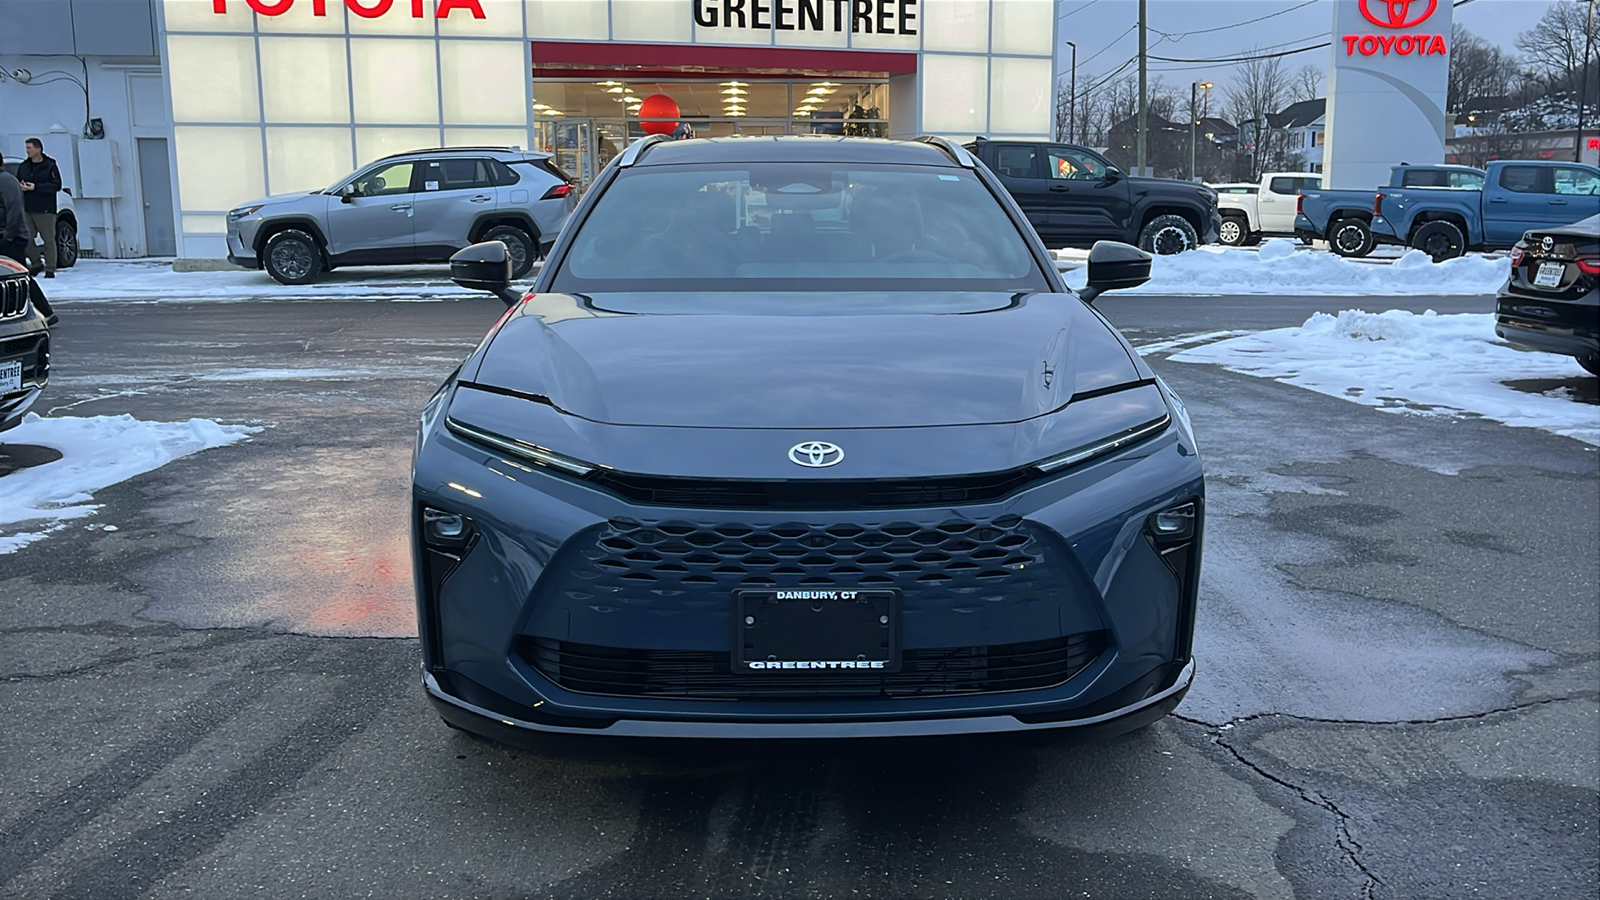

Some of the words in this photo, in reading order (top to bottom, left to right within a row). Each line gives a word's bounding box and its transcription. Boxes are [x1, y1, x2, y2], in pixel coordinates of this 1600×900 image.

[693, 0, 917, 35] GREENTREE
[1341, 33, 1447, 56] TOYOTA
[0, 366, 20, 379] ENTREE
[776, 591, 838, 600] DANBURY,
[840, 591, 857, 599] CT
[749, 661, 884, 669] GREENTREE
